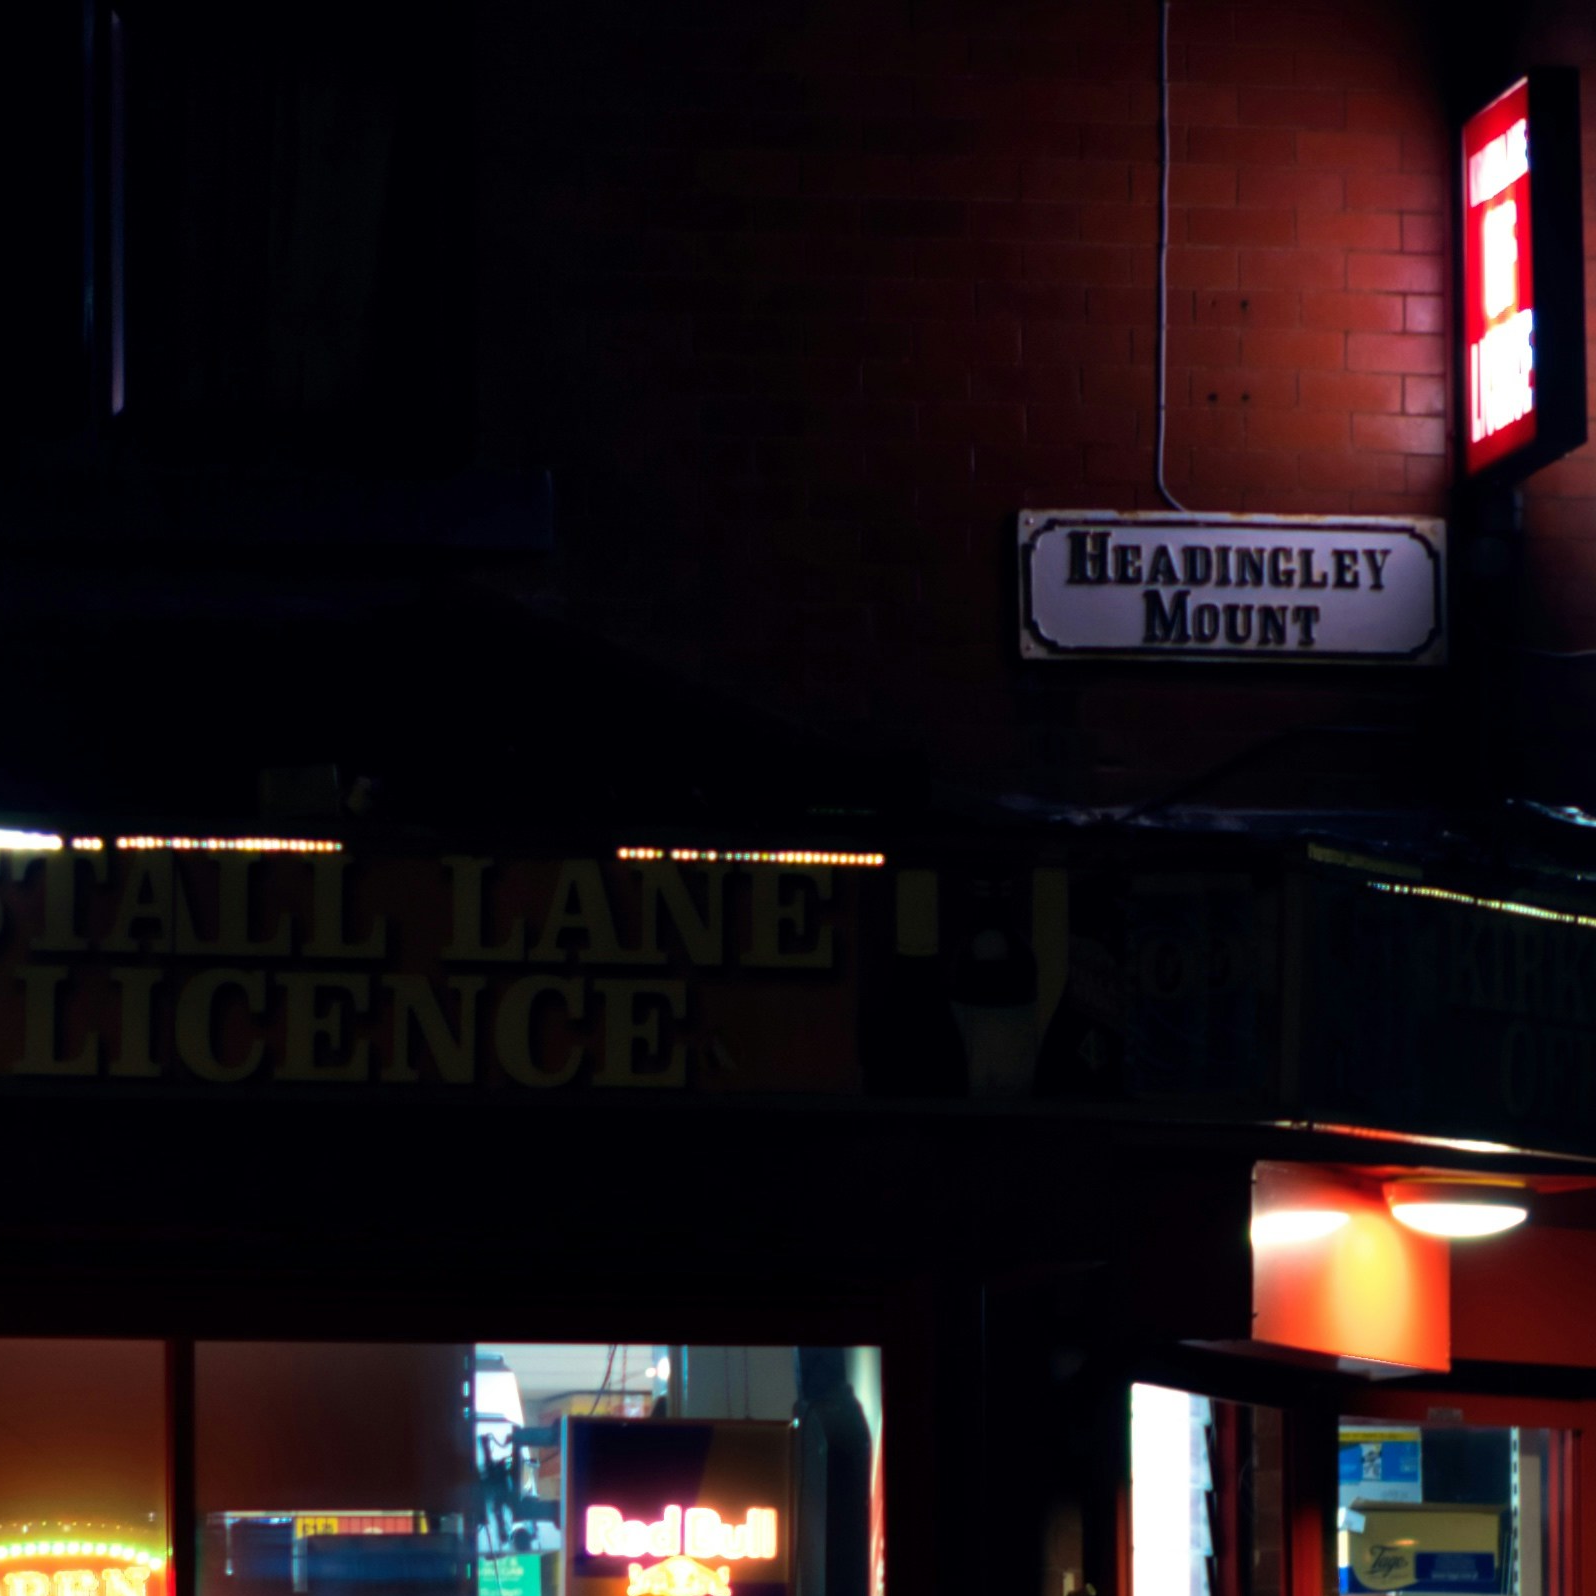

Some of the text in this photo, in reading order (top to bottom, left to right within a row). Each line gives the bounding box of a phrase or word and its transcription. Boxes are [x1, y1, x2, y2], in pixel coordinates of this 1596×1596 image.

[441, 852, 838, 971] LANE
[15, 962, 690, 1090] LICENCE
[585, 1504, 682, 1558] Red
